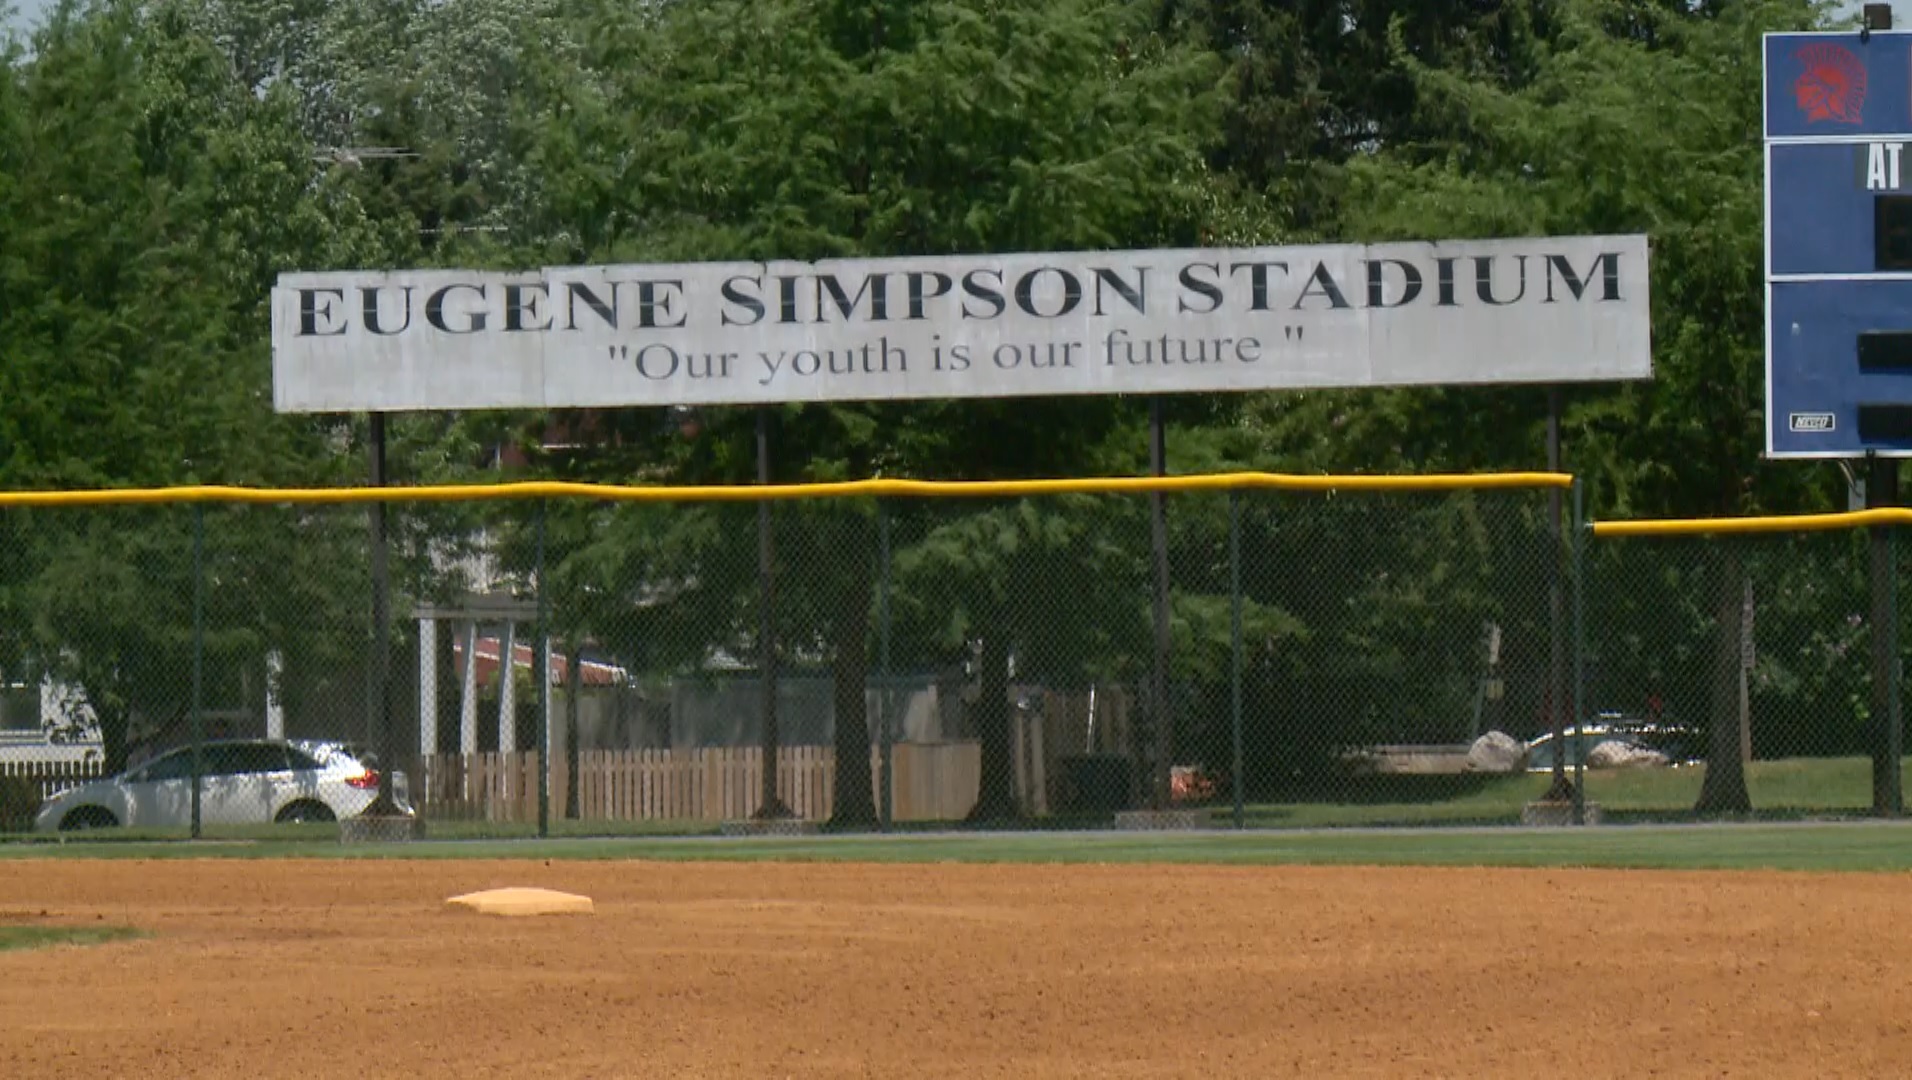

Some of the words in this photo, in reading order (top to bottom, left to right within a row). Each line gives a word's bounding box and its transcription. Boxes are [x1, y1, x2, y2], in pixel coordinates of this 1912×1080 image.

[1867, 142, 1903, 190] AT
[295, 279, 689, 337] EUGENE
[719, 266, 1151, 326] SIMPSON
[1178, 251, 1626, 313] STADIUM
[607, 343, 738, 381] "Our
[757, 335, 908, 386] youth
[931, 333, 972, 372] is
[992, 342, 1083, 370] our
[1105, 328, 1262, 367] future
